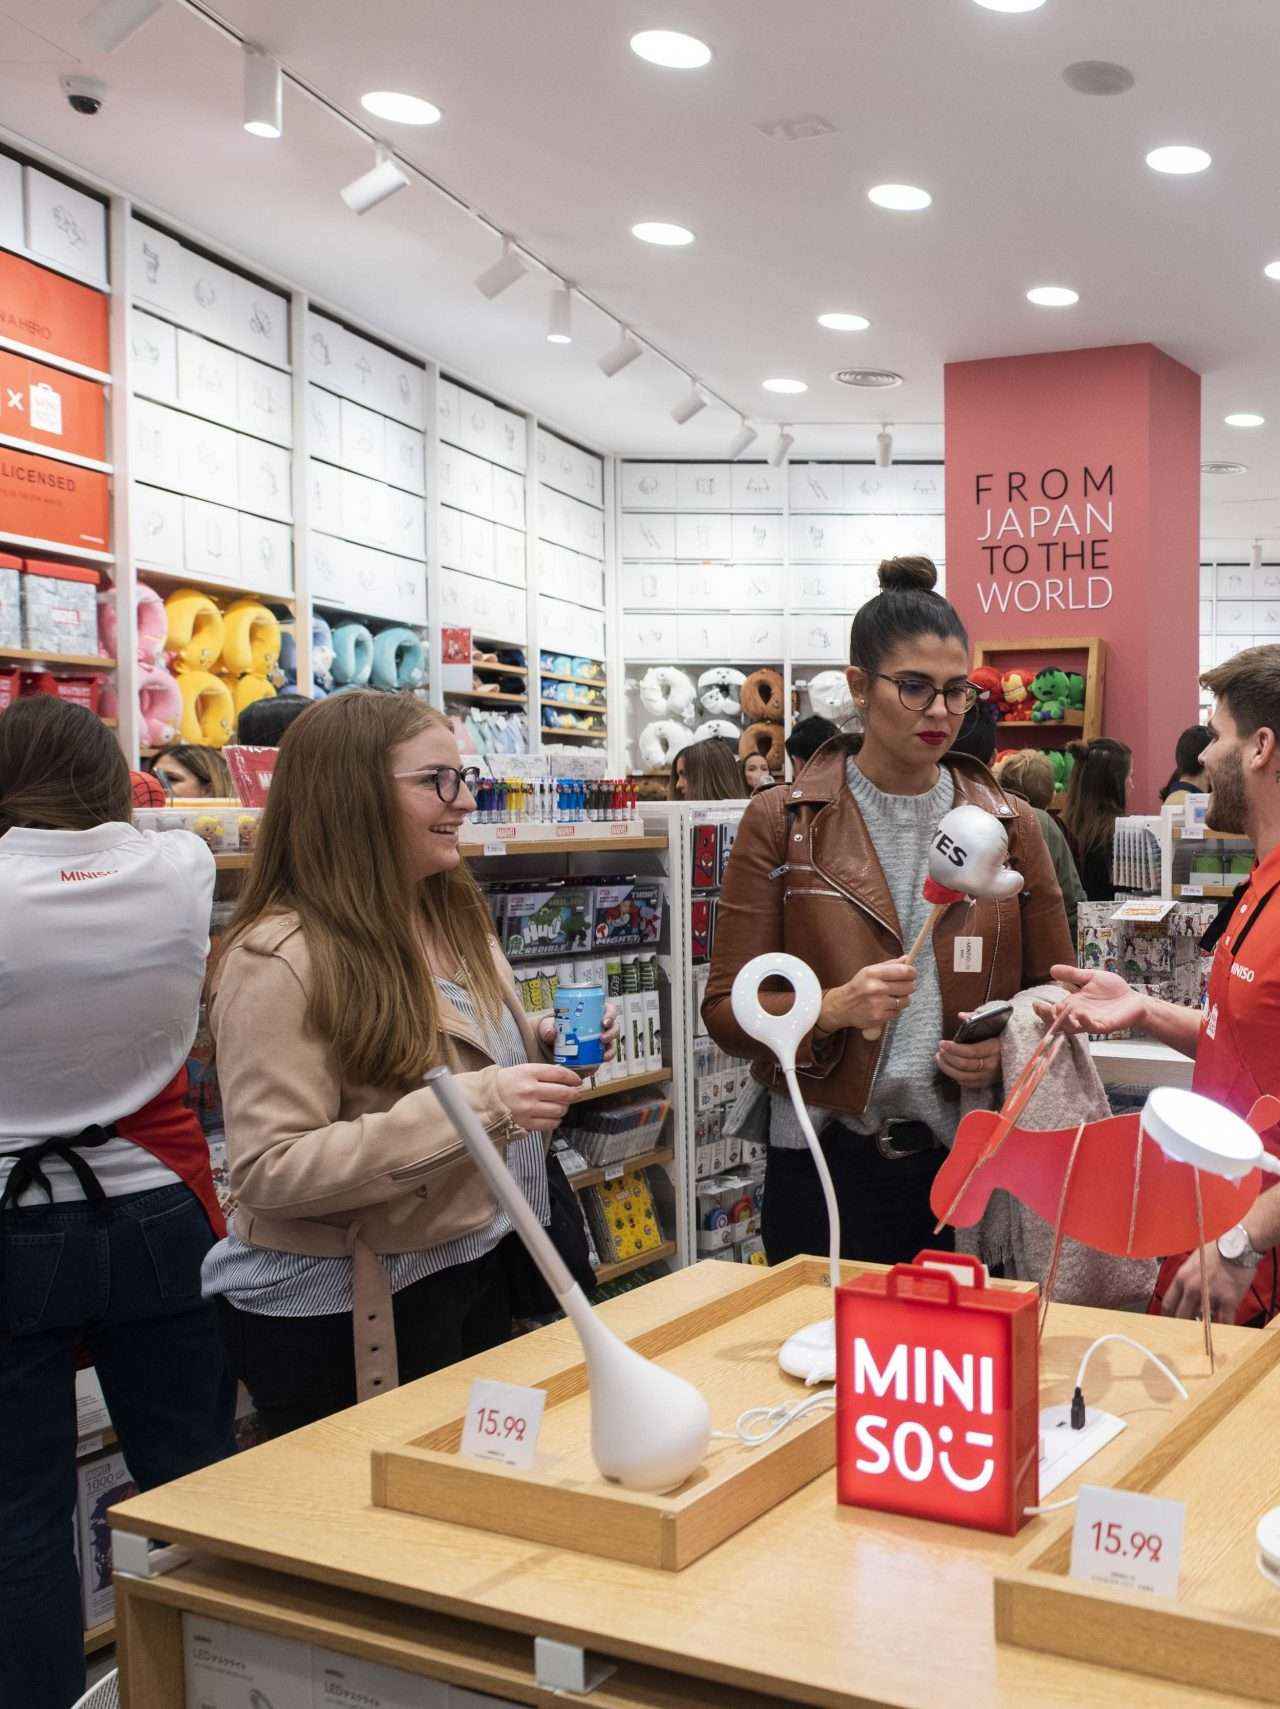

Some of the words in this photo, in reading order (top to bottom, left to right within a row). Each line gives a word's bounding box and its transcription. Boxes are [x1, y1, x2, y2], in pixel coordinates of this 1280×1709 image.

[1, 462, 76, 492] LICENSED
[976, 465, 1113, 505] FROM
[976, 501, 1113, 541] JAPAN
[982, 544, 1029, 576] TO
[1038, 539, 1109, 572] THE
[976, 576, 1113, 614] WORLD
[853, 1337, 994, 1415] MINI
[477, 1408, 526, 1442] 15.99
[1091, 1521, 1162, 1562] 15.99
